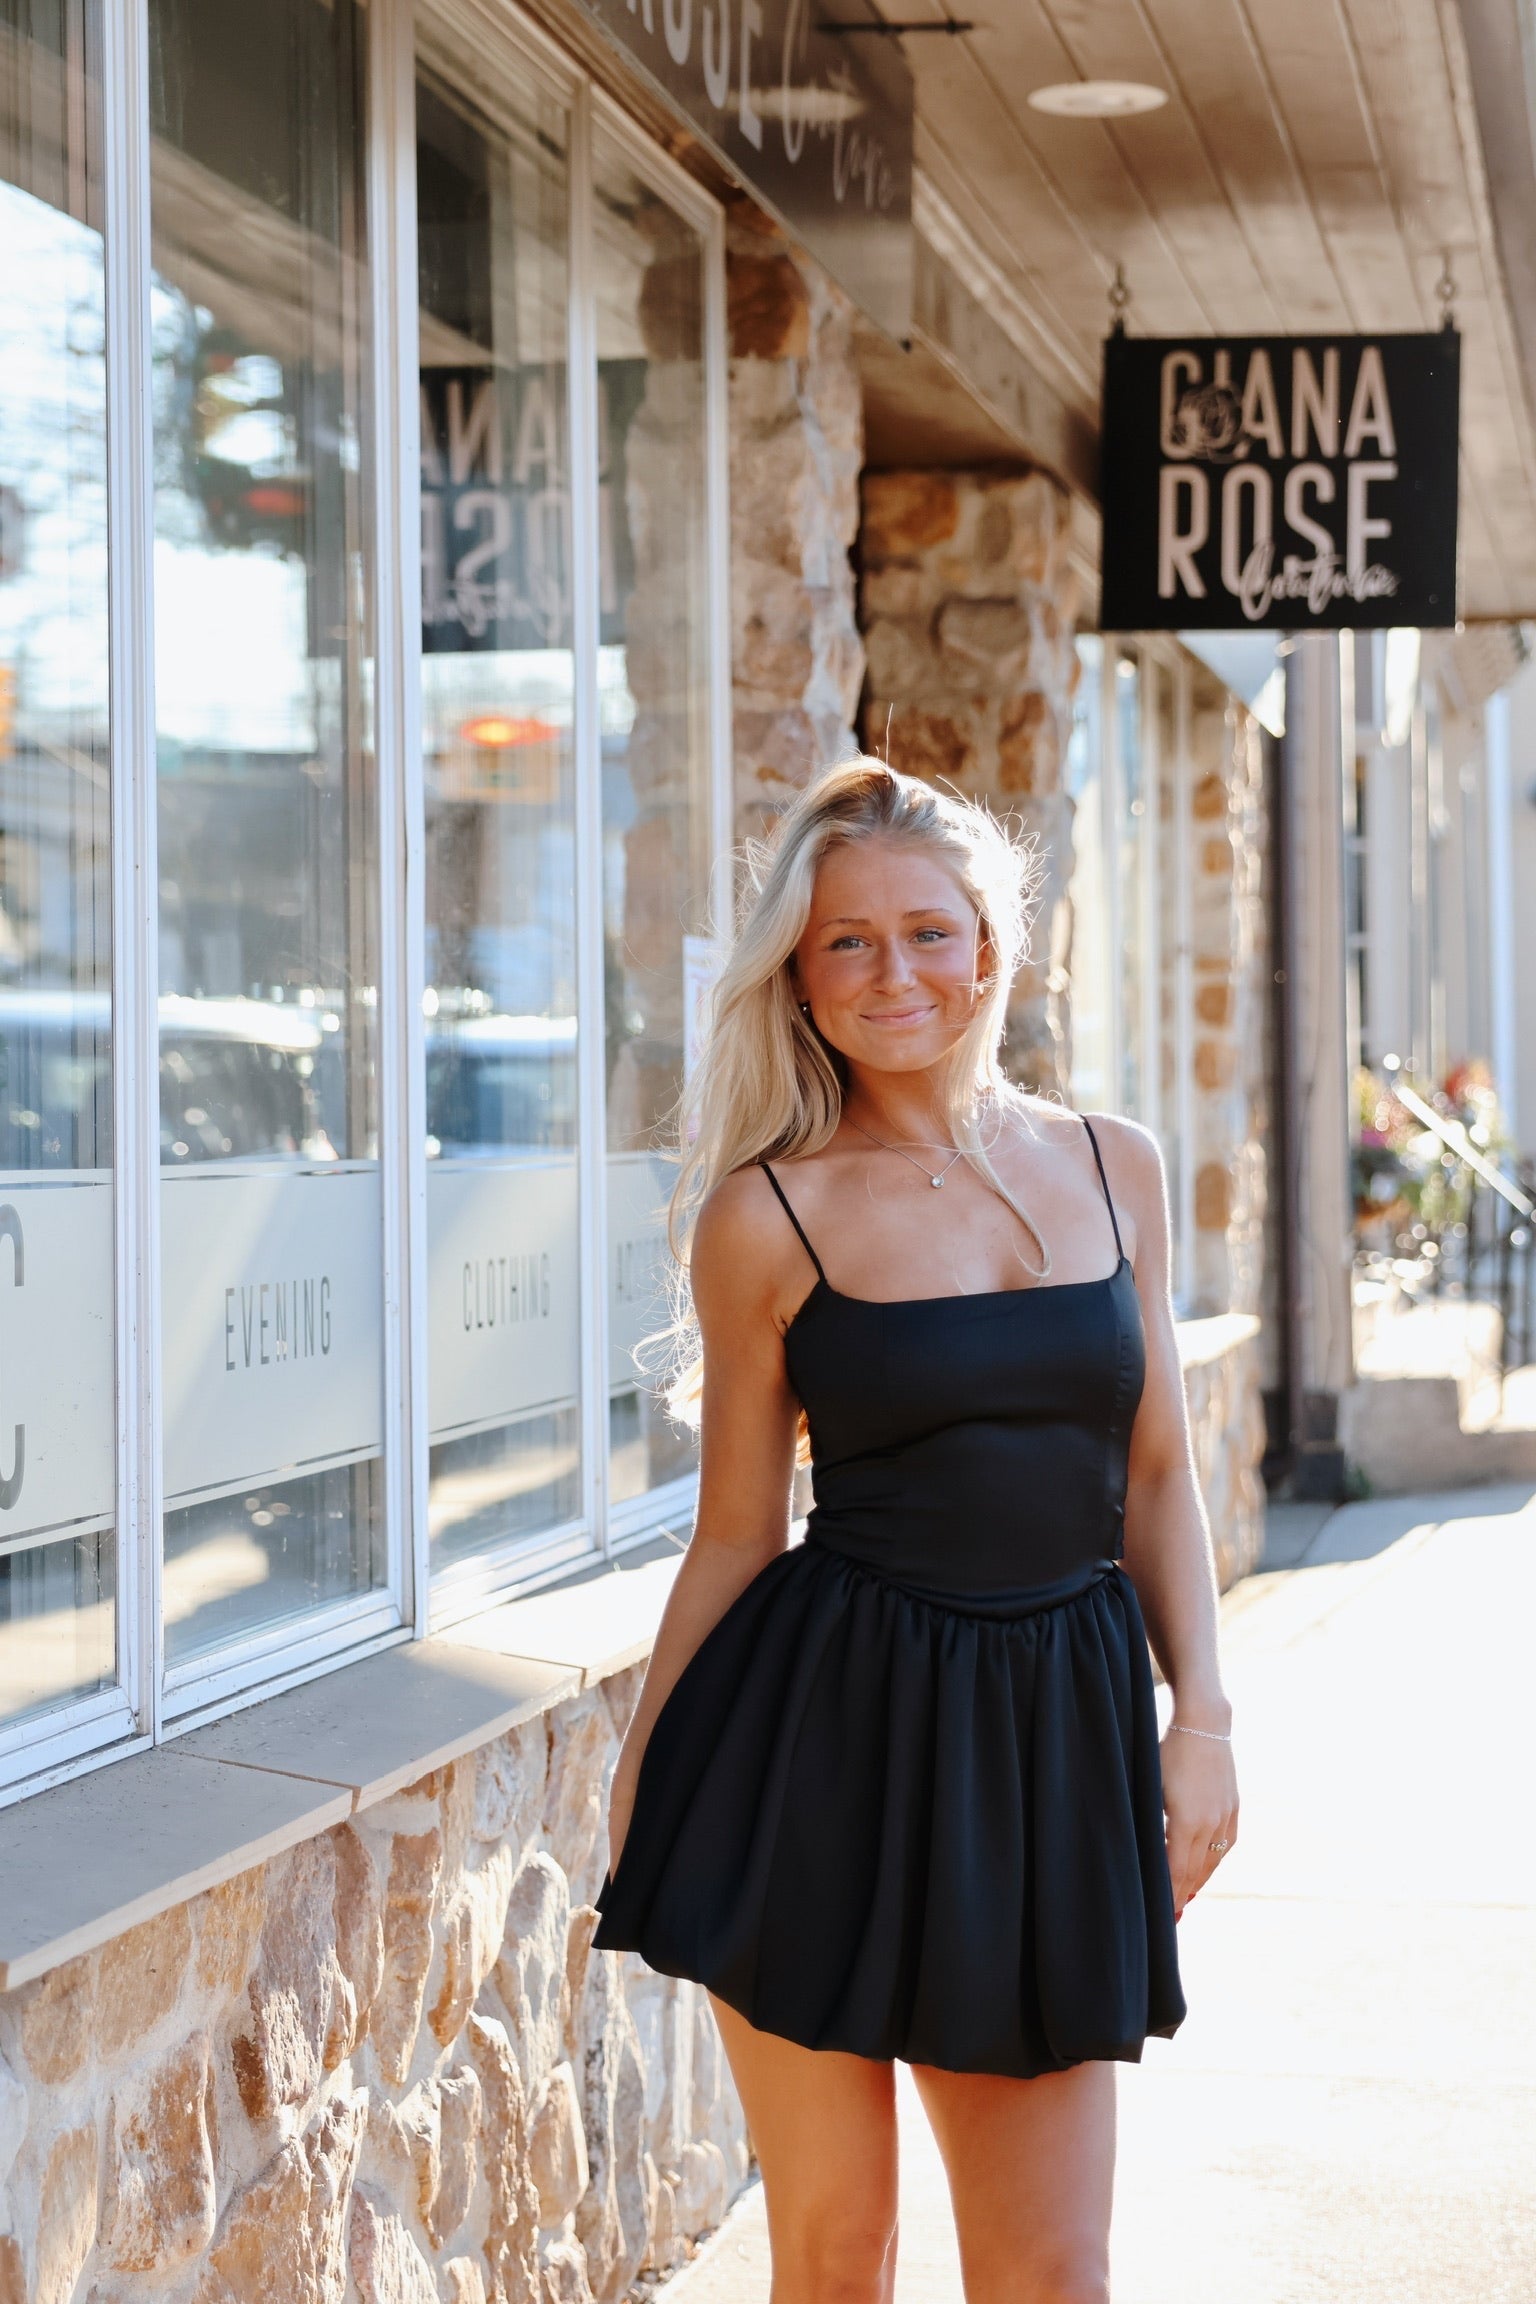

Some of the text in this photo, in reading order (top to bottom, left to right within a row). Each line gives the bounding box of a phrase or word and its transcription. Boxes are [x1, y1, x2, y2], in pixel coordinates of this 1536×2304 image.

[1157, 460, 1398, 601] ROSE
[225, 1275, 331, 1371] EVENING
[463, 1252, 550, 1331] CLOTHING
